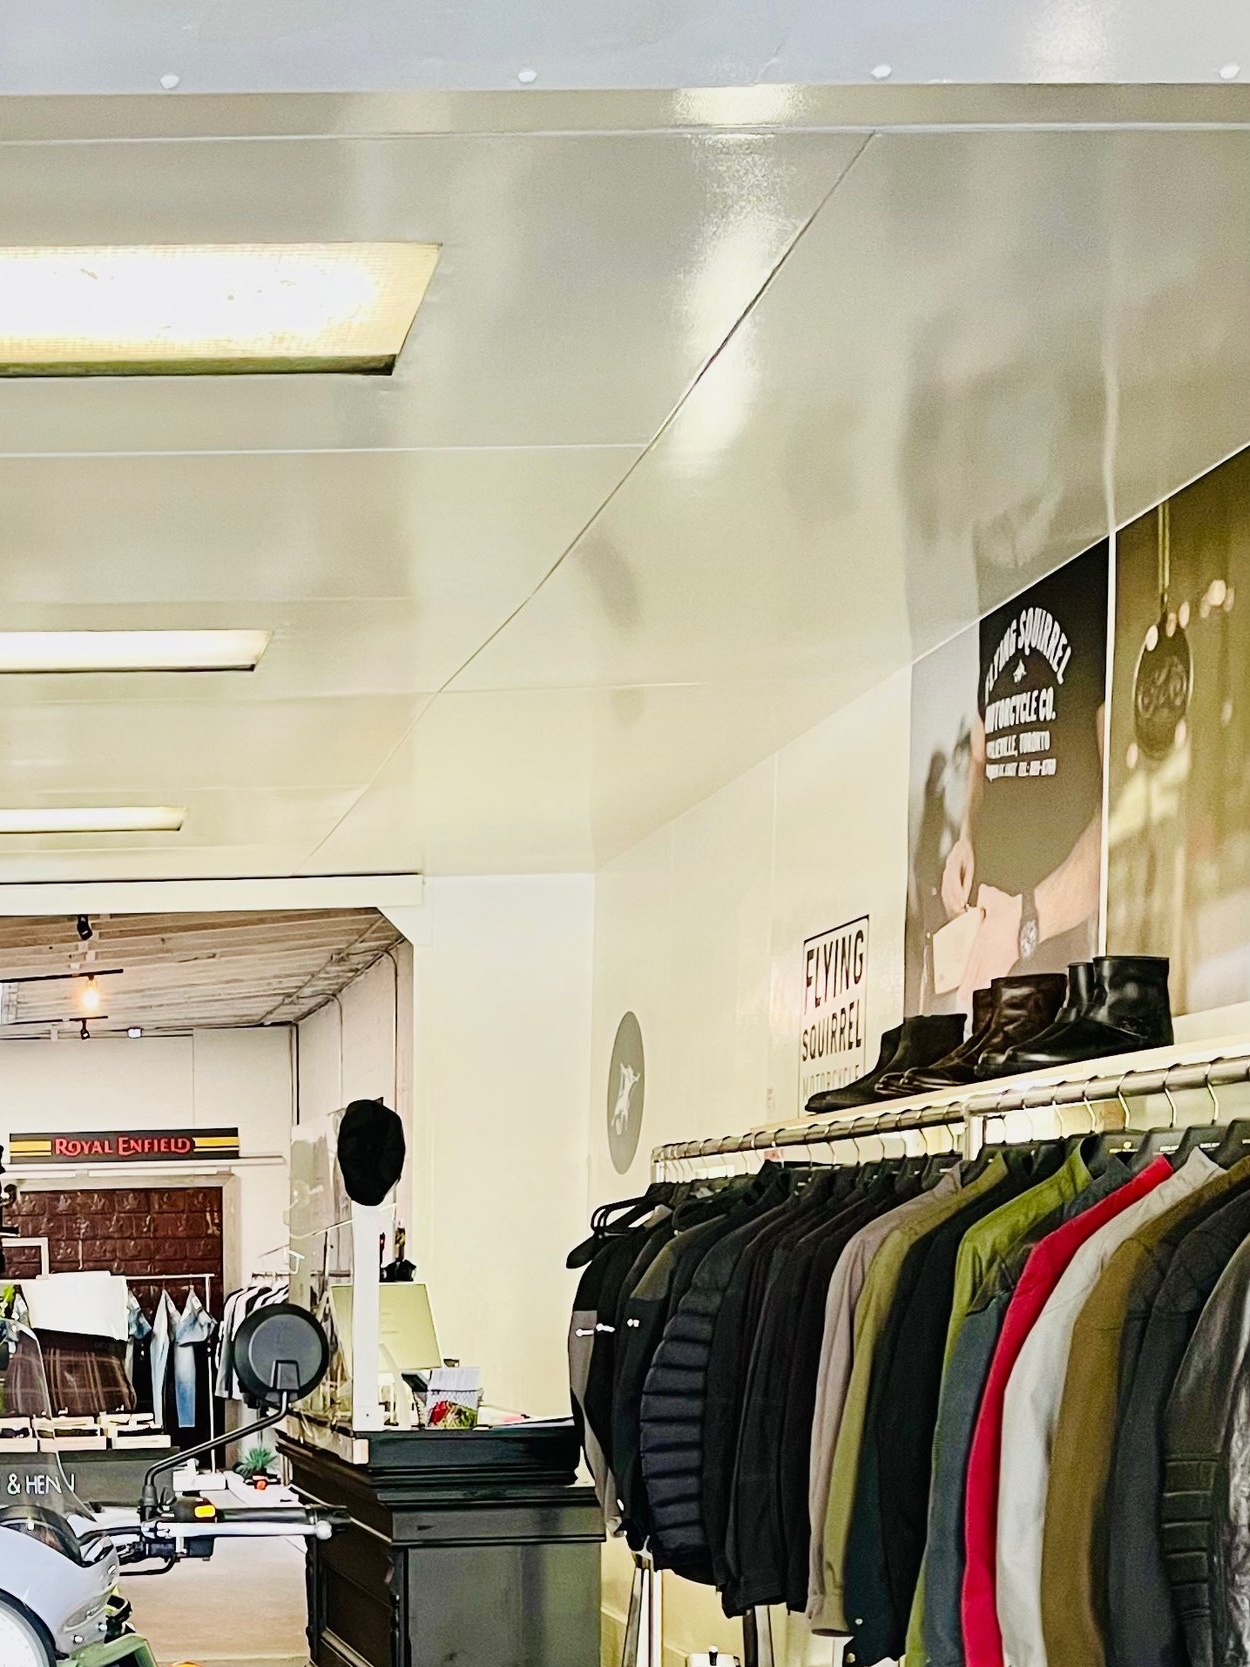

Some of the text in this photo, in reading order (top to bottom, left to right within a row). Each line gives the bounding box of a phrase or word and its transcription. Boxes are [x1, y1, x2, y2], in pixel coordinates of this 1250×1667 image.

[1017, 607, 1072, 685] SQUIRREL
[1038, 686, 1057, 721] CO.
[803, 929, 864, 1015] FLYING
[802, 999, 862, 1062] SQUIRREL
[55, 1136, 191, 1157] ROYAL ENFIELD
[7, 1473, 21, 1496] &
[25, 1473, 76, 1495] HEN
